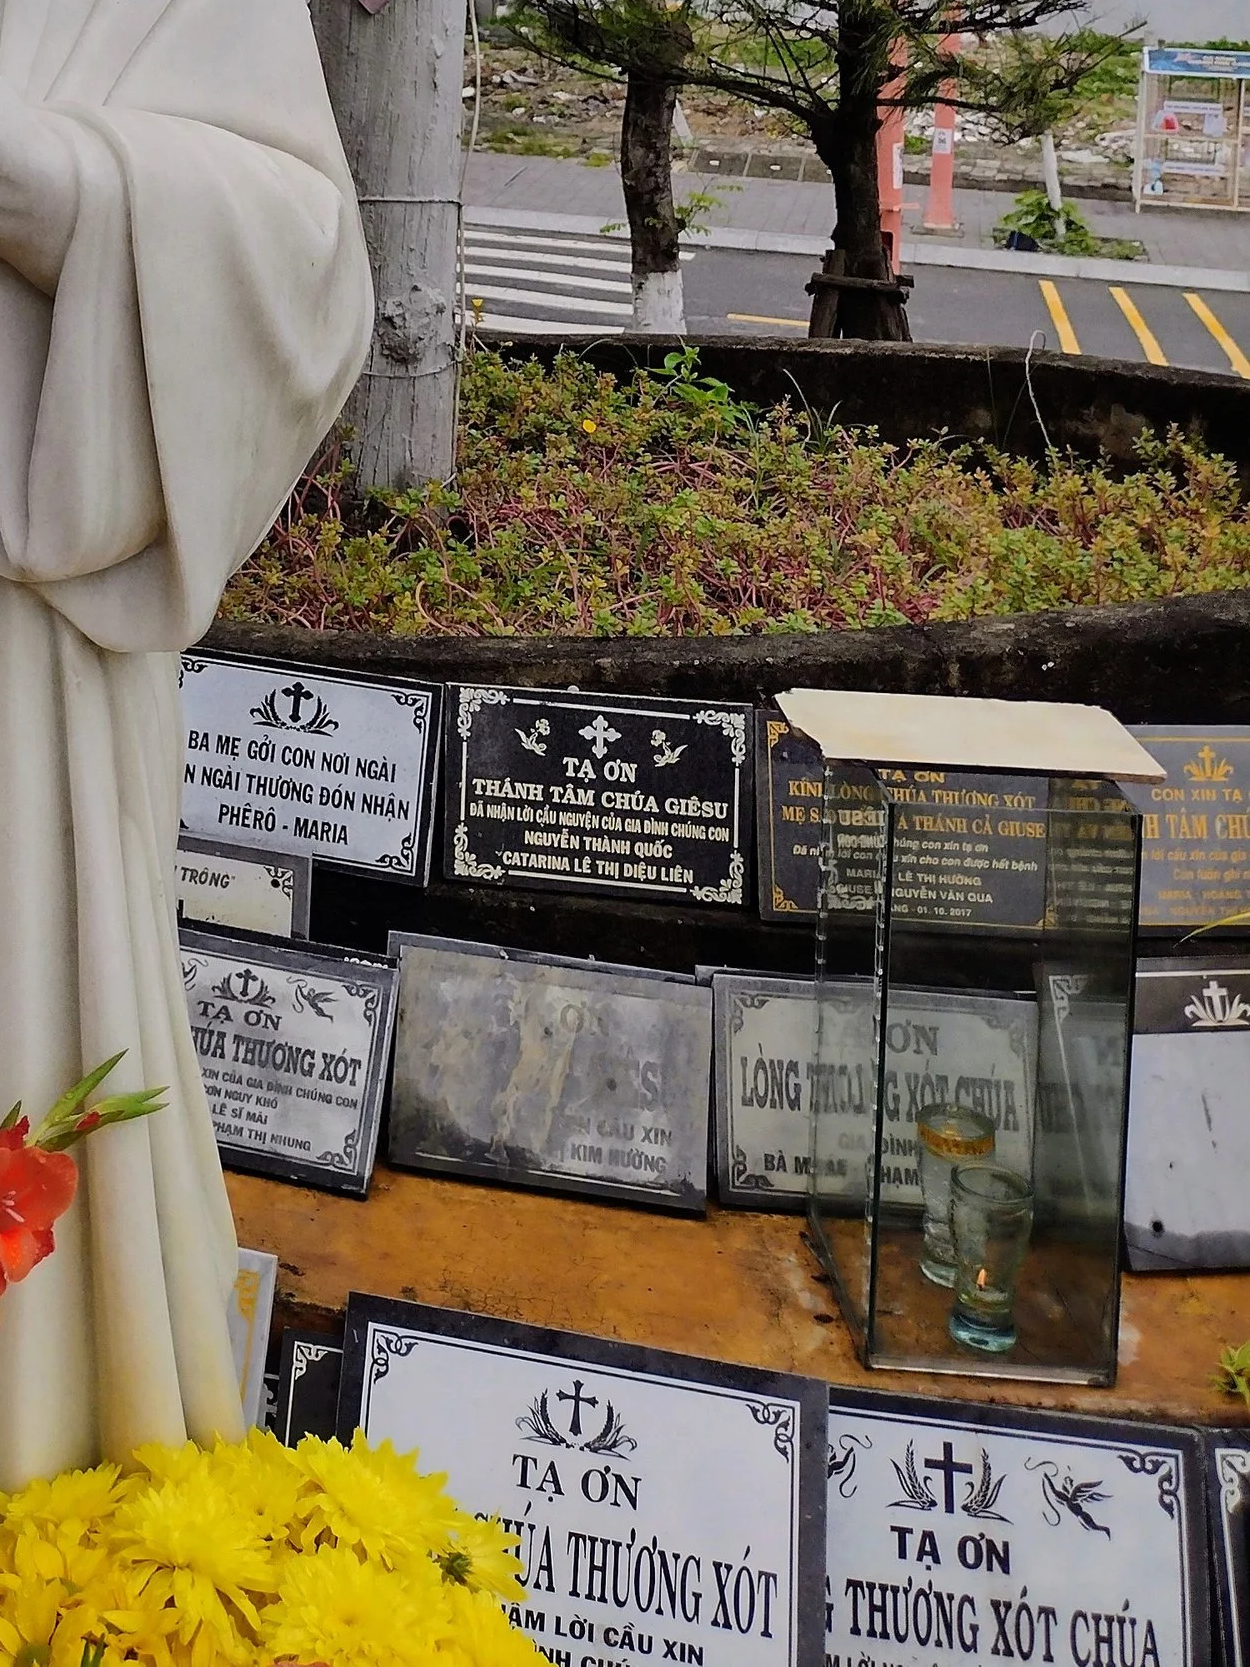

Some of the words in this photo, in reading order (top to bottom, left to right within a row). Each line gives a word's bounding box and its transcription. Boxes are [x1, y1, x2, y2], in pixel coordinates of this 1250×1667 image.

[187, 730, 209, 753] BA
[215, 734, 242, 762] MẸ
[247, 734, 277, 763] GỞI
[281, 745, 316, 770] CON
[320, 751, 351, 776] NƠI
[355, 755, 397, 784] NGÀI
[563, 756, 596, 783] TẠ
[603, 758, 638, 784] ƠN
[201, 764, 241, 792] NGÀI
[245, 773, 314, 805] THƯƠNG
[319, 783, 356, 811] ĐÓN
[361, 793, 410, 823] NHẬN
[472, 777, 544, 802] THÁNH
[549, 783, 595, 808] TÂM
[601, 789, 659, 814] CHÚA
[664, 795, 729, 820] GIÊSU
[1151, 788, 1185, 802] CON
[217, 802, 277, 833] PHÊRÔ
[293, 816, 349, 846] MARIA
[470, 800, 484, 817] ĐÃ
[486, 802, 515, 823] NHẬN
[517, 804, 534, 822] LỜI
[559, 810, 600, 831] NGUYỆN
[601, 811, 622, 832] CỦA
[624, 818, 642, 834] GIA
[643, 816, 669, 836] ĐÌNH
[670, 820, 706, 840] CHÚNG
[708, 826, 729, 842] CON
[781, 805, 806, 825] MẸ
[913, 812, 968, 834] THÁNH
[998, 820, 1046, 838] GIUSE
[1165, 807, 1208, 839] TÂM
[524, 828, 580, 850] NGUYỄN
[582, 834, 631, 855] THÀNH
[634, 839, 673, 859] QUỐC
[502, 850, 570, 871] CATARINA
[574, 856, 591, 873] LÊ
[596, 860, 619, 879] THỊ
[623, 861, 657, 881] DIỆU
[660, 864, 694, 884] LIÊN
[197, 1000, 233, 1024] TẠ
[244, 1009, 283, 1031] ƠN
[232, 1034, 316, 1079] THƯƠNG
[318, 1047, 362, 1087] XÓT
[740, 1042, 801, 1112] LÒNG
[295, 1088, 333, 1105] CHÚNG
[335, 1096, 358, 1111] CON
[270, 1133, 311, 1152] NHUNG
[641, 1124, 672, 1147] XIN
[511, 1453, 566, 1504] TẠ
[581, 1464, 643, 1512] ƠN
[889, 1524, 942, 1571] TẠ
[957, 1533, 1011, 1576] ƠN
[566, 1526, 703, 1625] THƯƠNG
[710, 1544, 779, 1639] XÓT
[554, 1613, 596, 1643] LỜI
[603, 1621, 654, 1655] CẦU
[662, 1637, 705, 1667] XIN
[845, 1575, 981, 1655] THƯƠNG
[990, 1584, 1058, 1663] XÓT
[1069, 1597, 1161, 1667] CHÚA
